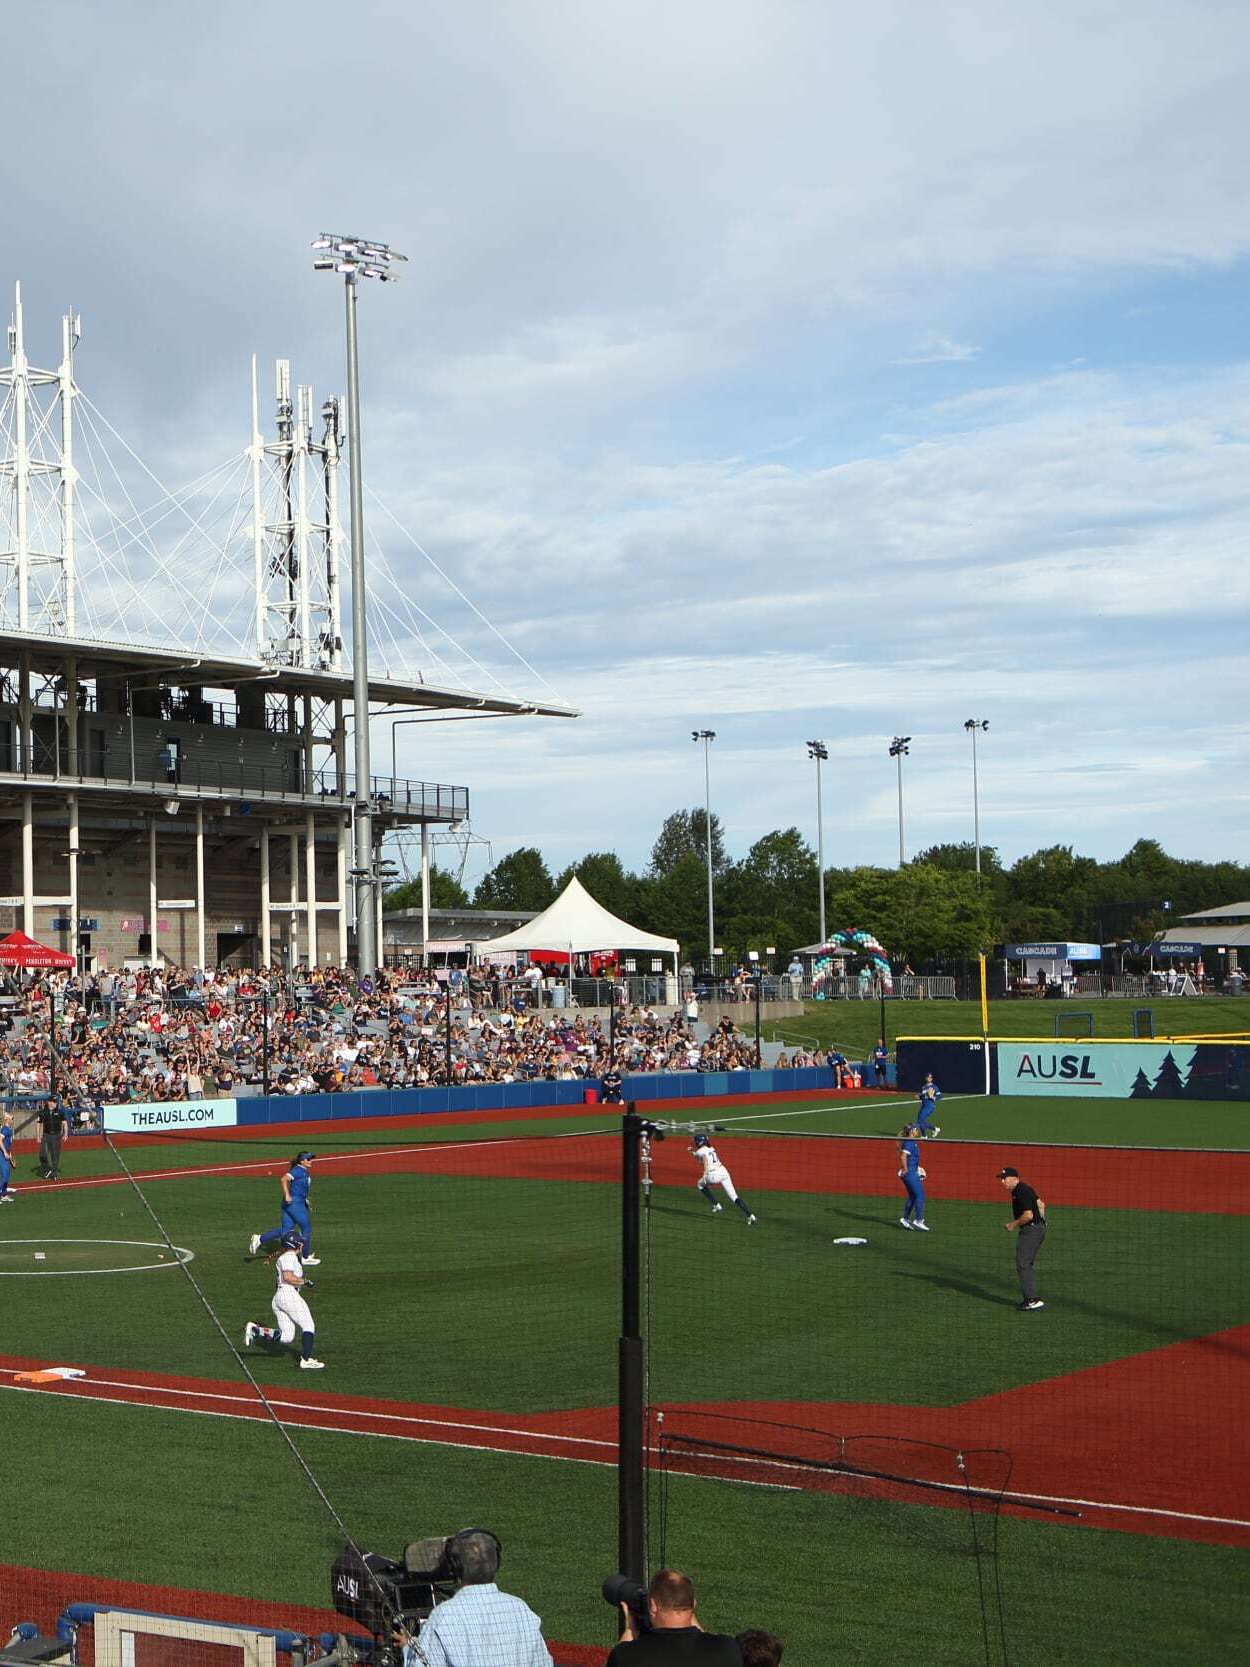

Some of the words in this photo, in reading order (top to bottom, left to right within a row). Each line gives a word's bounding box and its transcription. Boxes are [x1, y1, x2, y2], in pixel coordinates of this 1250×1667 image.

[1015, 946, 1057, 955] CASCADE
[1017, 1055, 1096, 1079] AUSL
[131, 1108, 214, 1126] THEAUSL.COM
